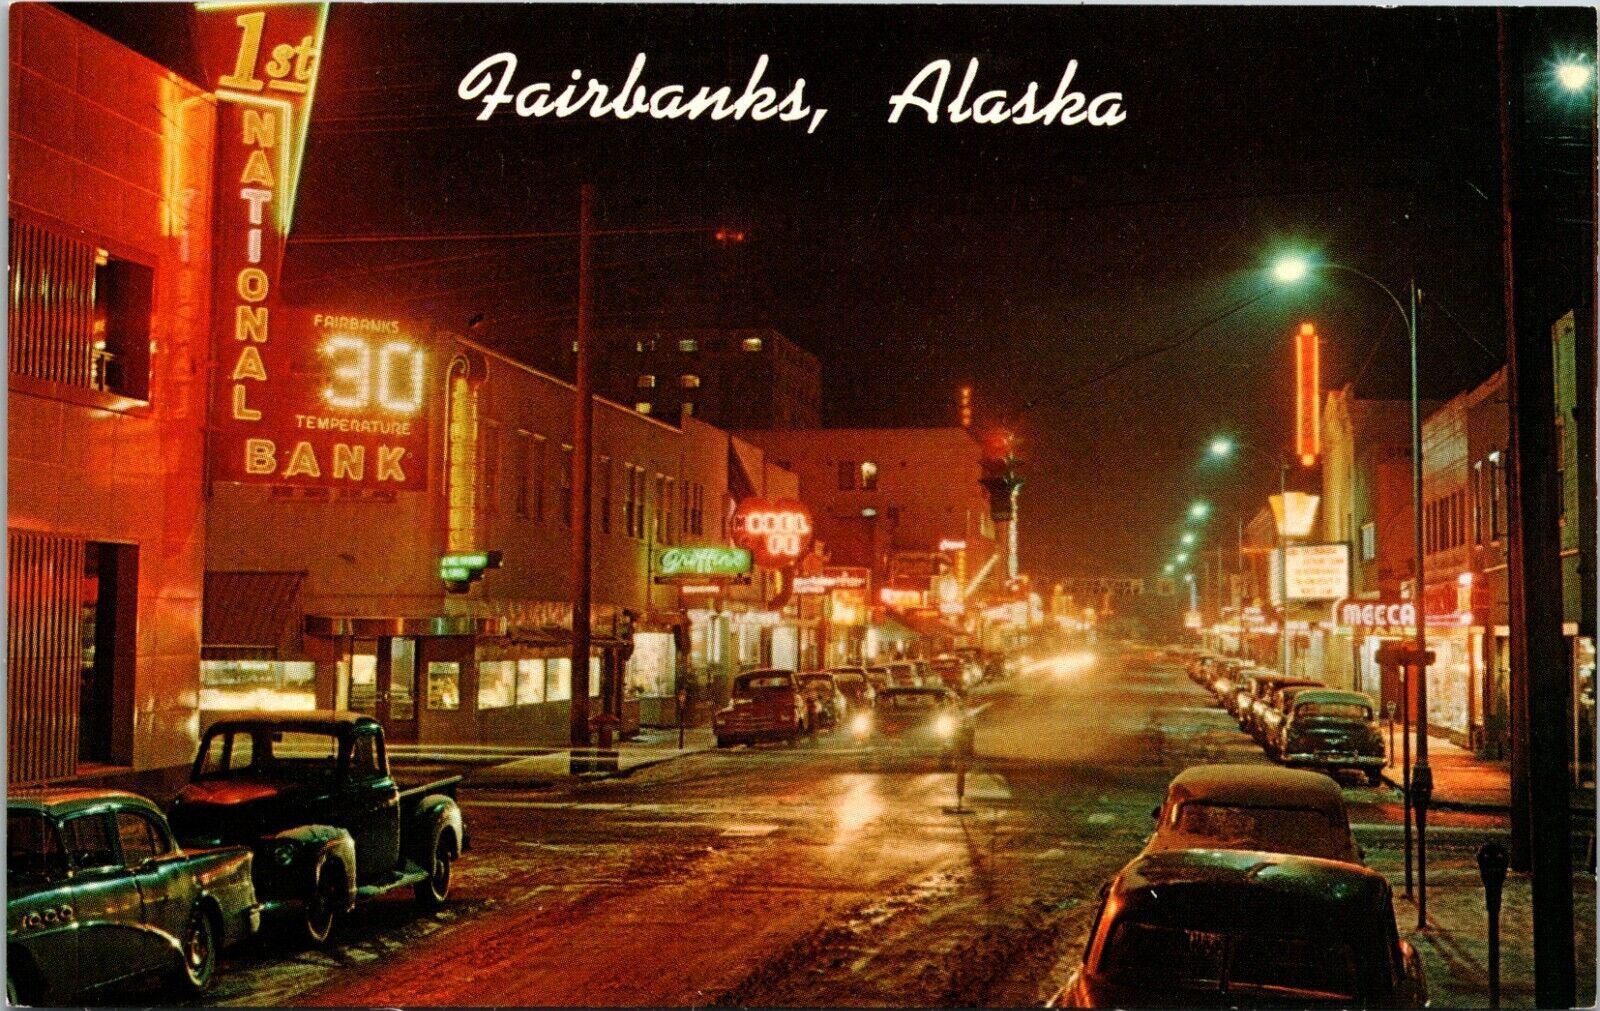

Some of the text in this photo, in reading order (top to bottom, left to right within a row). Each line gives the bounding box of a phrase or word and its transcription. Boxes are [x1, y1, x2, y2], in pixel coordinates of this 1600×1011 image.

[219, 12, 317, 93] 1st
[232, 109, 275, 421] NATIONAL
[313, 314, 399, 333] FAIRBANKS
[321, 337, 425, 412] 30
[295, 414, 411, 436] TEMPERATURE
[246, 439, 406, 481] BANK
[1343, 603, 1416, 626] MECCA
